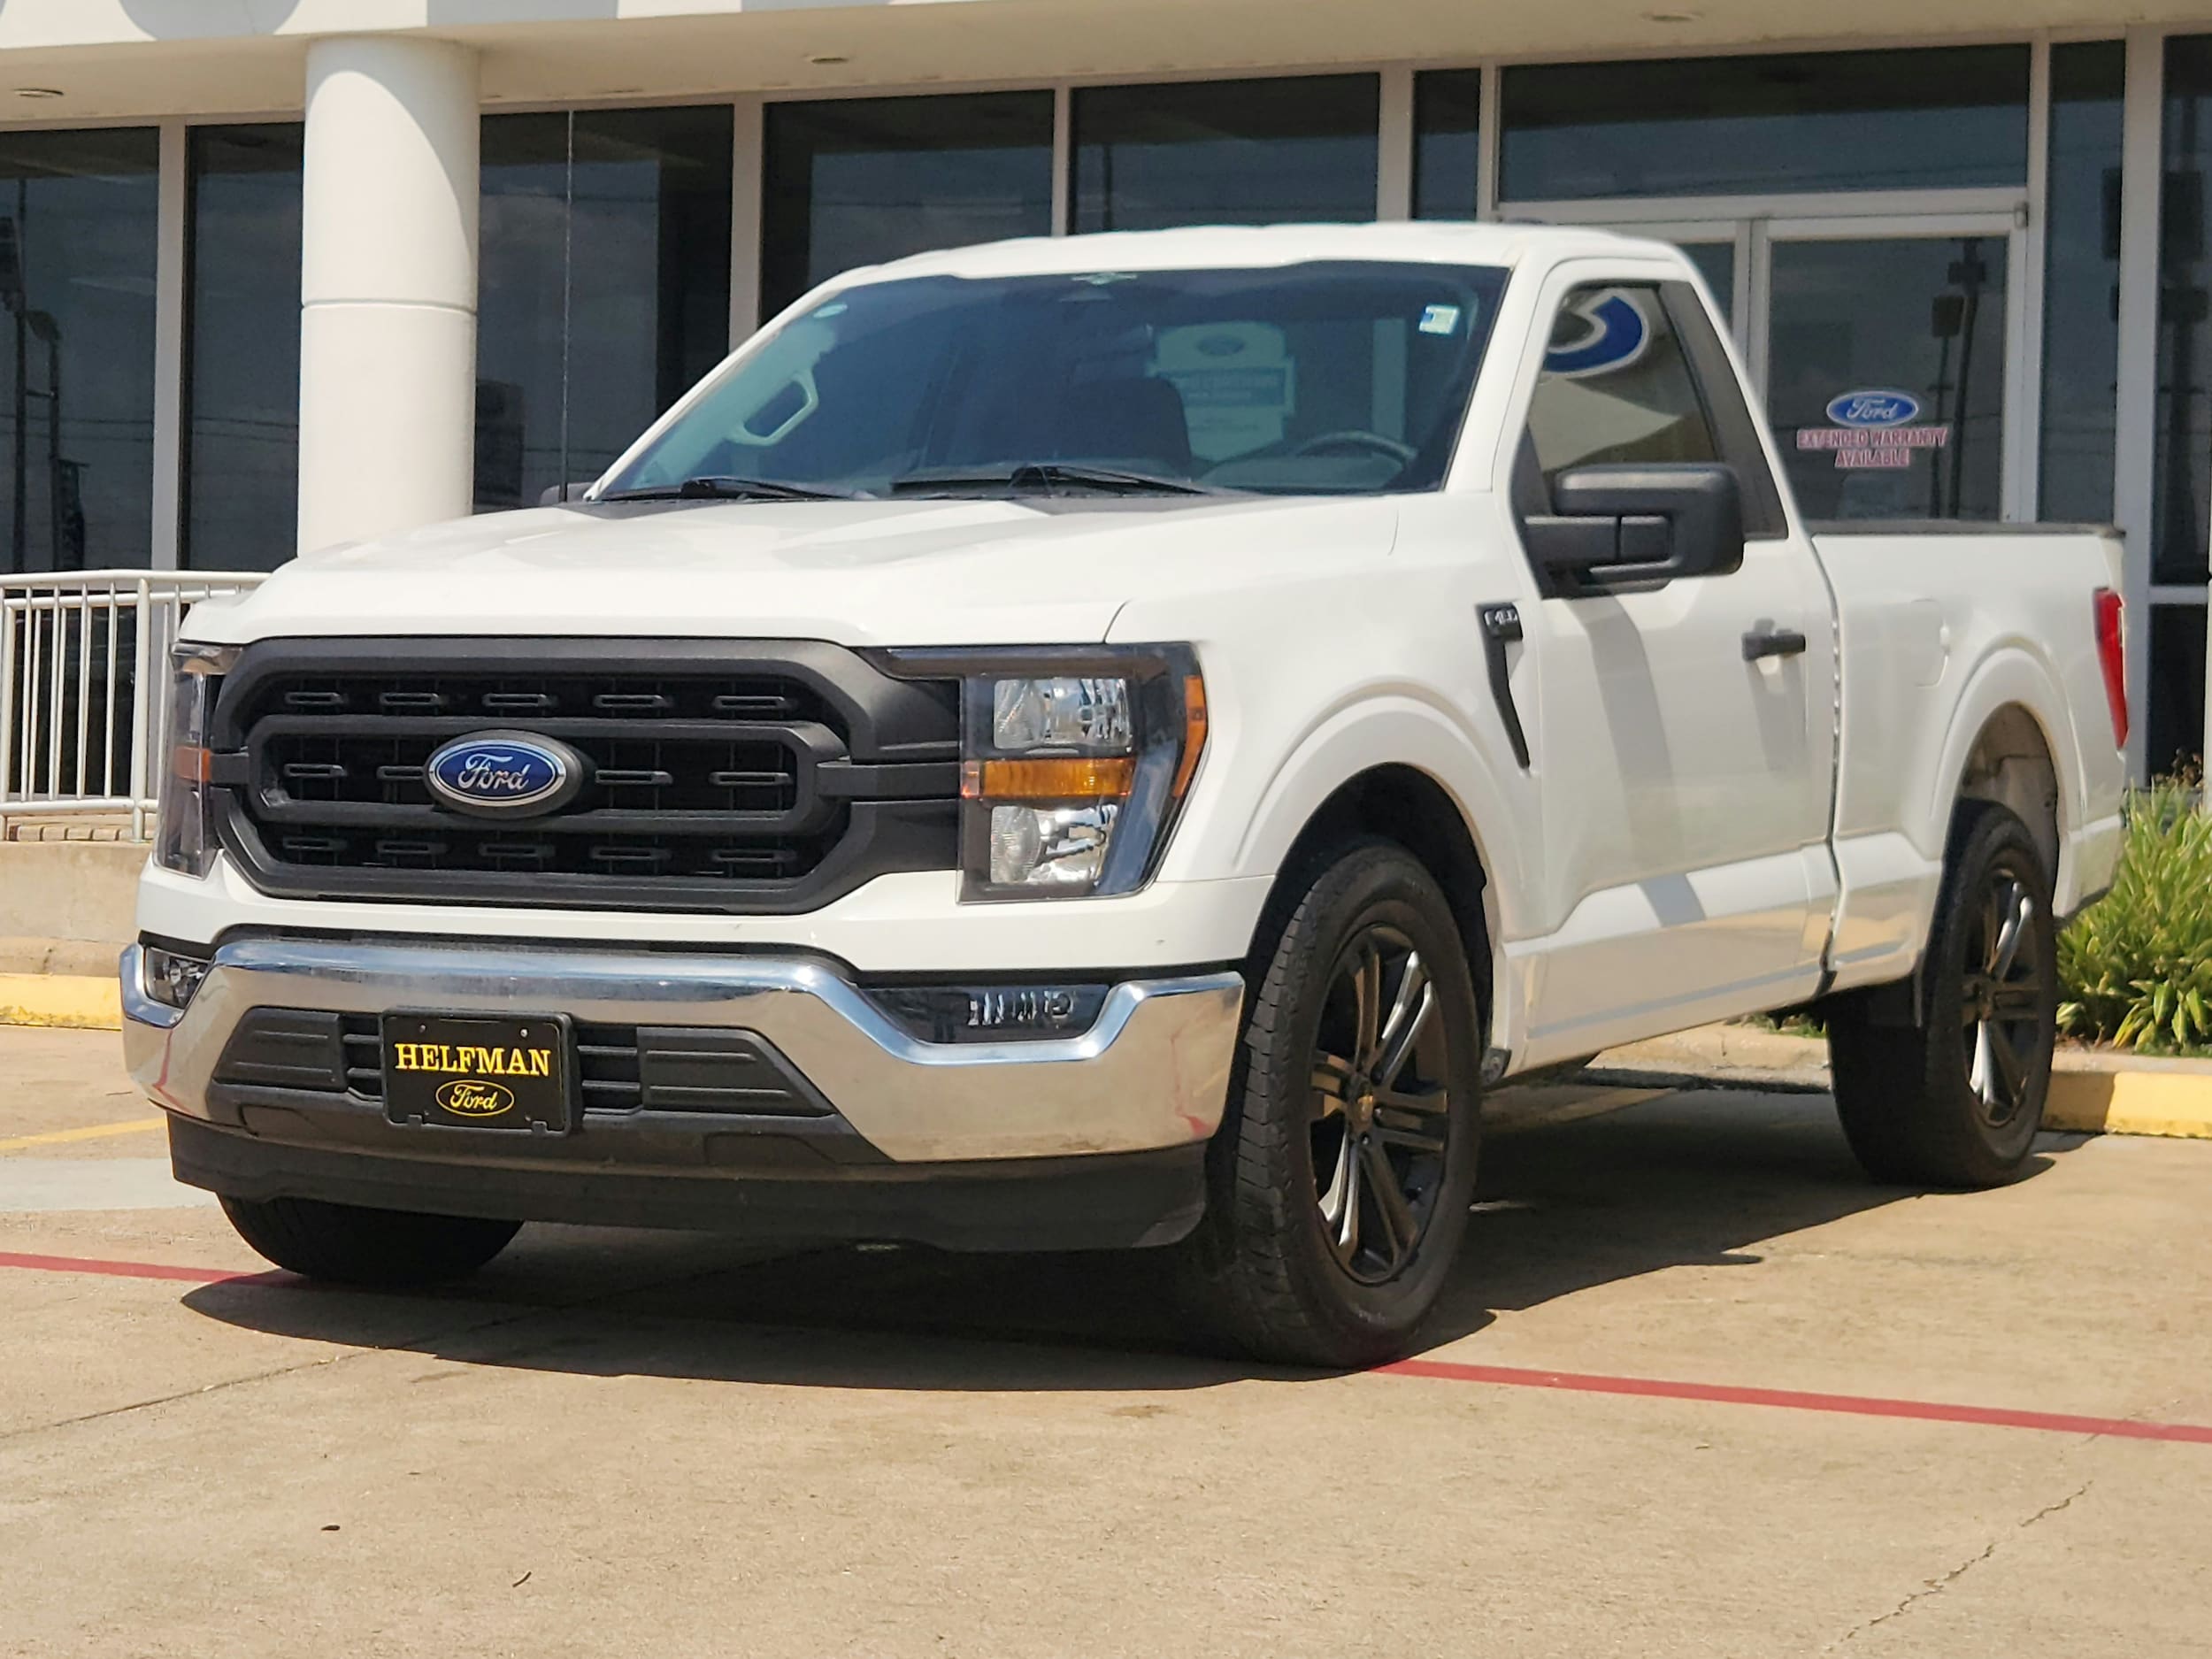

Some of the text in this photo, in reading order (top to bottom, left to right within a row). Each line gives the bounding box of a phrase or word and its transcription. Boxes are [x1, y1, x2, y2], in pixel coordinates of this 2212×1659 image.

[1847, 399, 1899, 420] Ford
[1870, 427, 1947, 447] WARRANTY
[1834, 448, 1909, 467] AVAILABLE
[457, 753, 531, 790] Ford
[395, 1042, 551, 1076] HELFMAN
[449, 1084, 497, 1110] Ford
